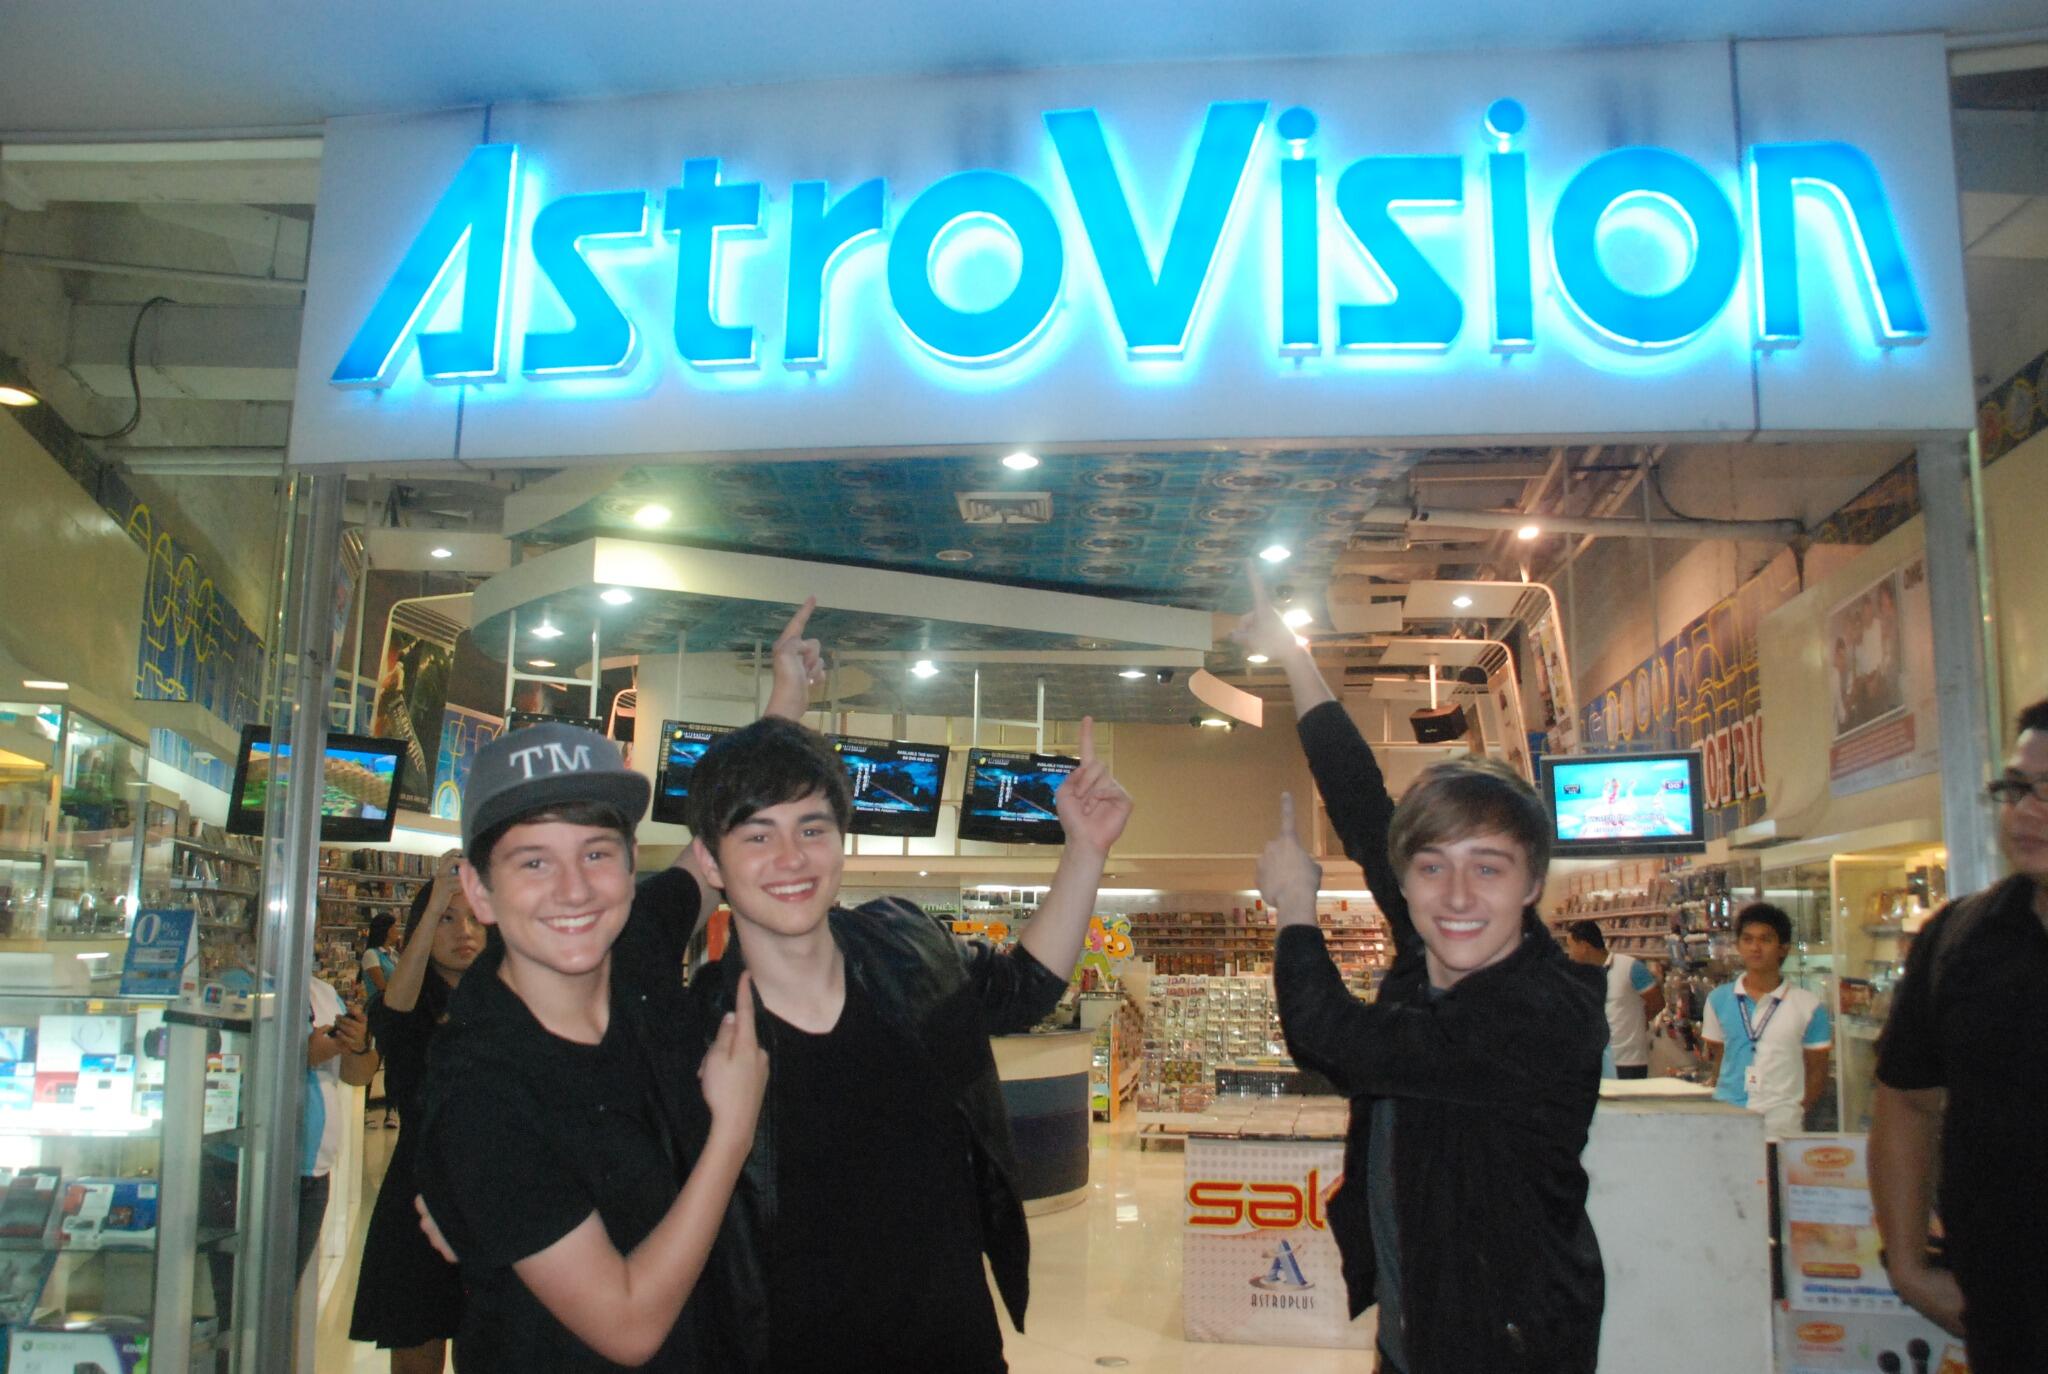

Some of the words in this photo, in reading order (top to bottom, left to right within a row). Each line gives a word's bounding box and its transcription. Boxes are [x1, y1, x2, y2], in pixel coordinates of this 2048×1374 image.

[331, 97, 1929, 391] AstroVision
[509, 742, 591, 779] TM
[1691, 727, 1732, 810] OT
[1186, 1168, 1344, 1231] sal
[1251, 1293, 1315, 1310] ASTROPLUS
